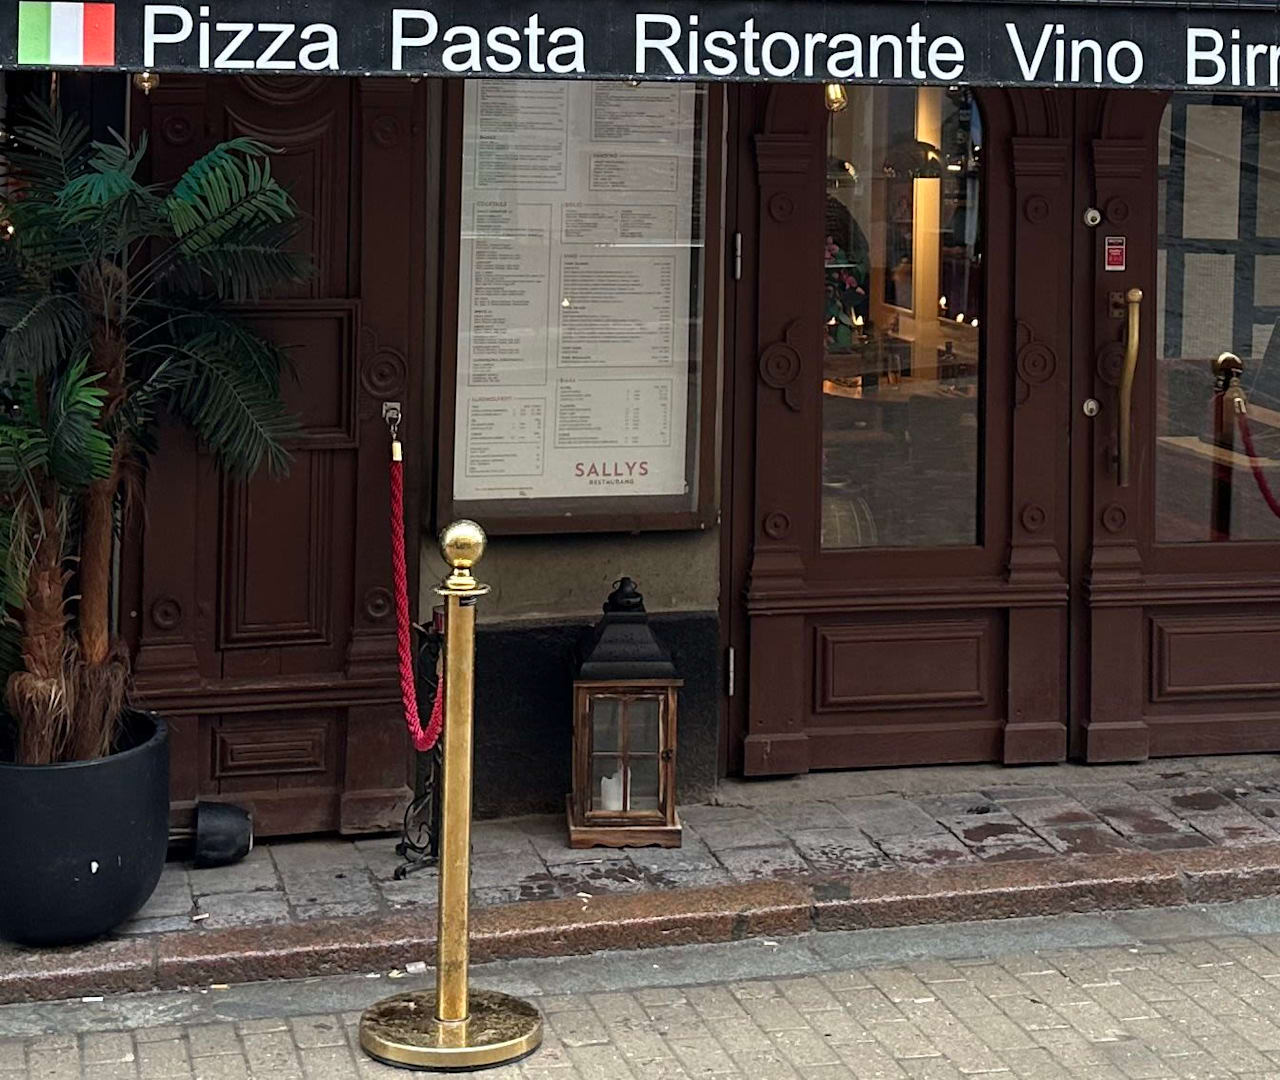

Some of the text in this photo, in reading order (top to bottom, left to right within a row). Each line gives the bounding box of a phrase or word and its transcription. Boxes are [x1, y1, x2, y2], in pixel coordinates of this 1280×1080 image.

[143, 4, 341, 72] Pizza
[390, 8, 587, 75] Pasta
[633, 12, 965, 81] Ristorante
[1005, 22, 1144, 84] Vino
[574, 461, 650, 478] SALLYS
